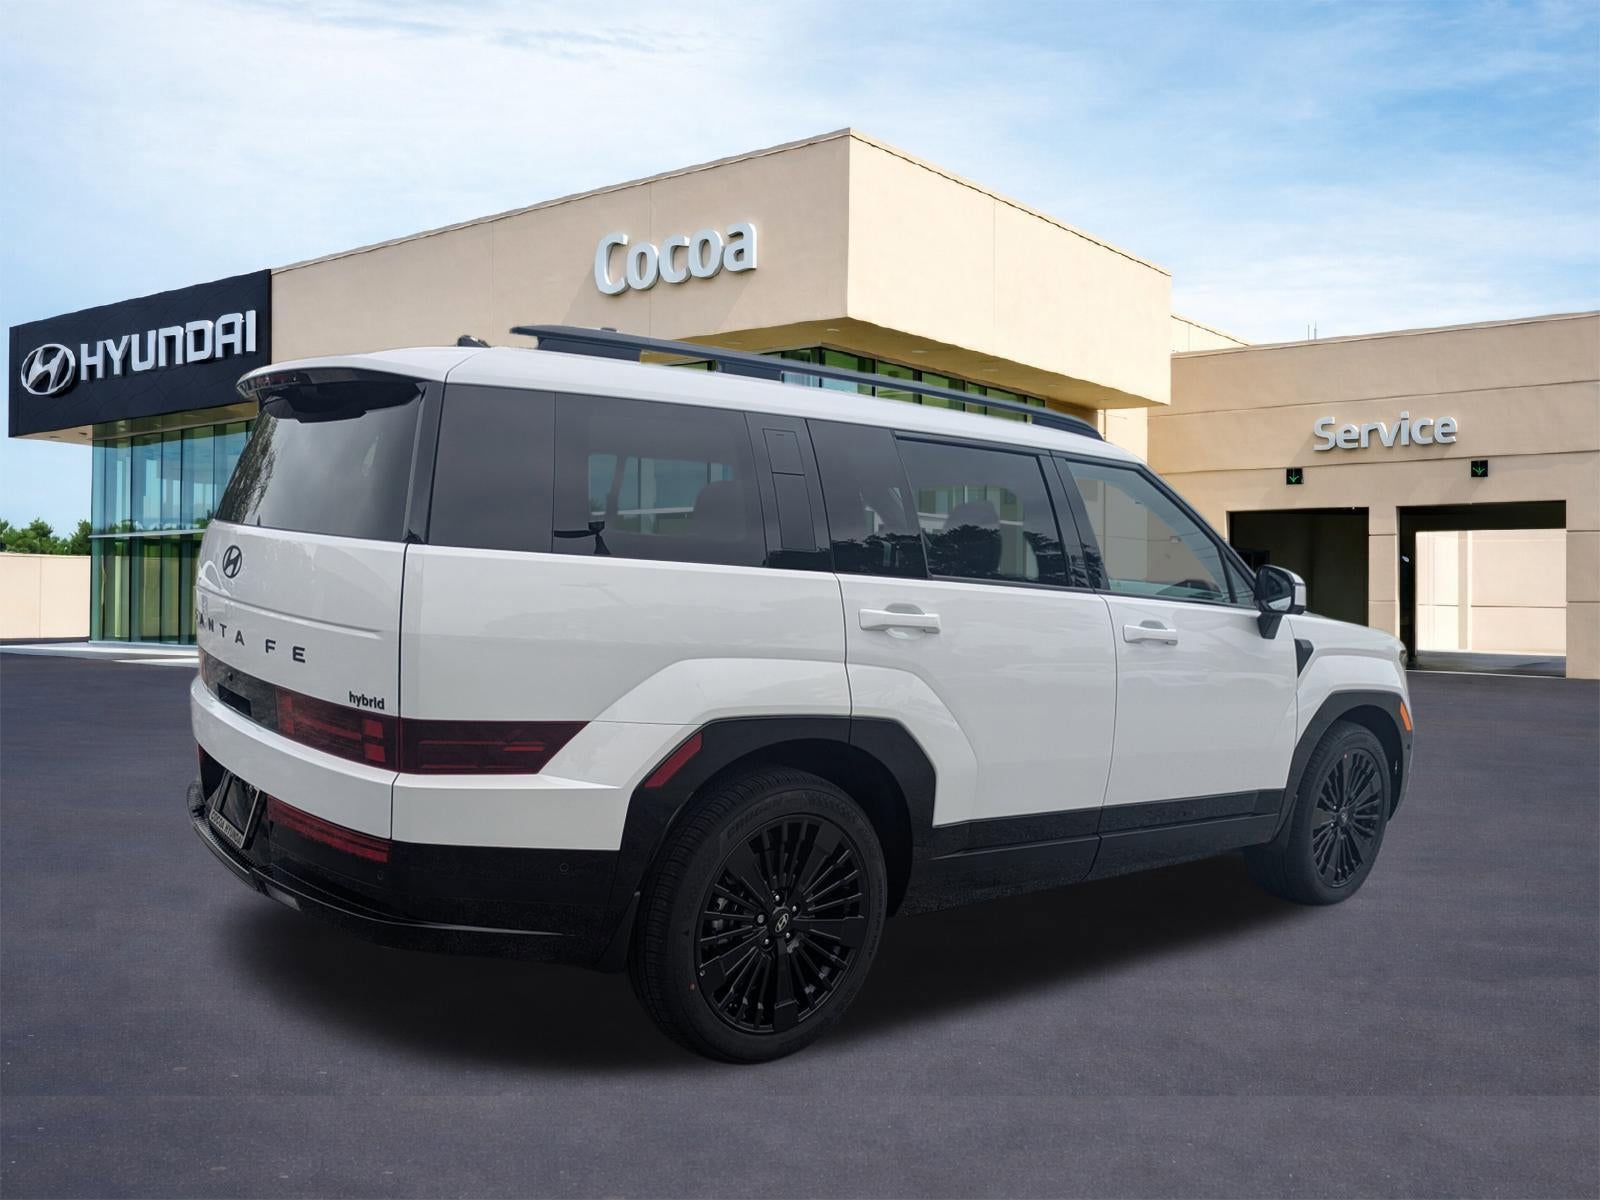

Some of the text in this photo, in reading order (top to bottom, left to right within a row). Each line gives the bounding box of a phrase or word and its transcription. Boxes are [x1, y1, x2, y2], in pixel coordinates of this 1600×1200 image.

[594, 223, 757, 295] Cocoa
[80, 310, 256, 381] HYUNDAI
[1313, 411, 1458, 451] Service
[265, 639, 306, 663] FE
[349, 691, 384, 711] hybrid
